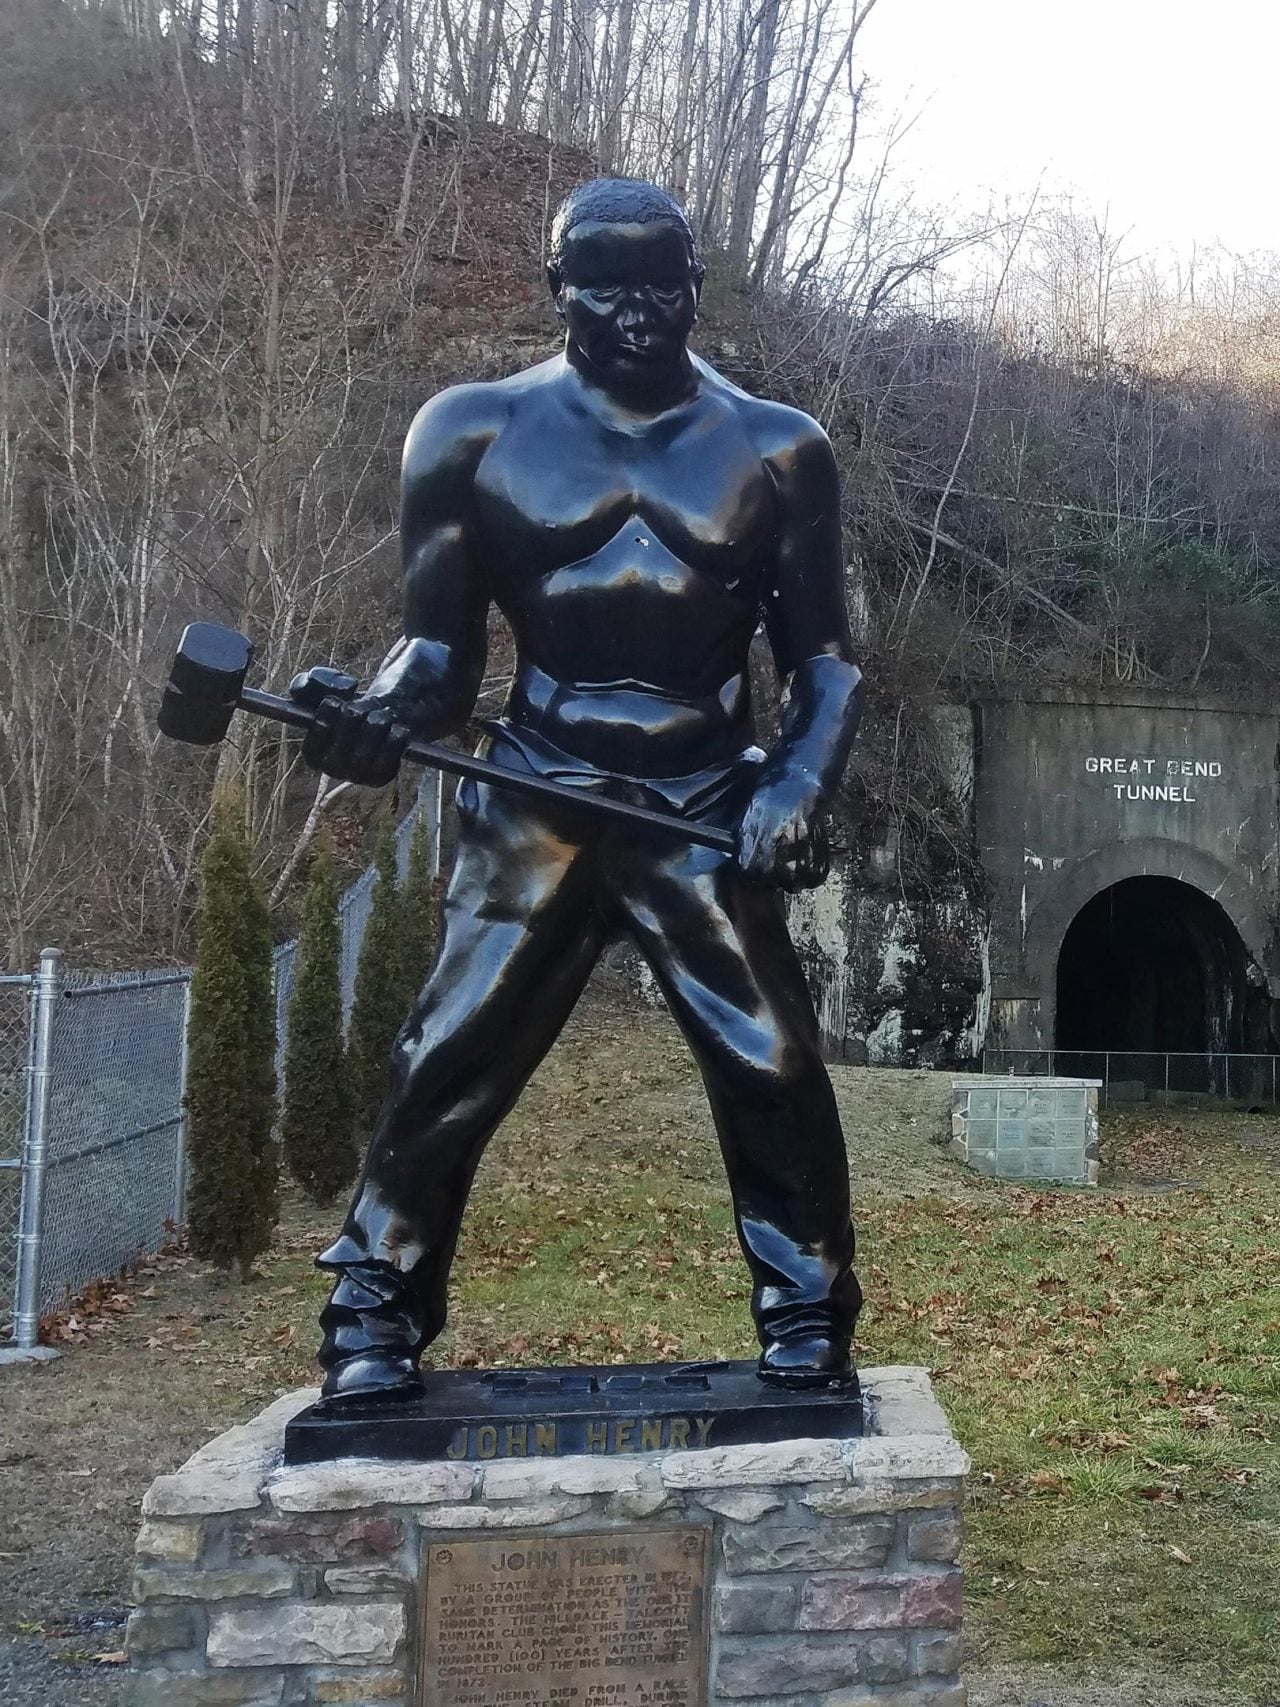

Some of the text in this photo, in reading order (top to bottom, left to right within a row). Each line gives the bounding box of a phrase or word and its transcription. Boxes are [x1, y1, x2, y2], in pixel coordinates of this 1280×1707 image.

[1085, 757, 1223, 777] GREAT BEND
[1113, 784, 1196, 802] TUNNEL
[446, 1416, 717, 1460] JOHN HENRY
[491, 1546, 646, 1572] JOHN HENRY
[454, 1583, 483, 1592] THIS
[579, 1574, 638, 1586] ERECTED
[440, 1596, 457, 1606] BY
[466, 1595, 475, 1604] A
[484, 1592, 533, 1604] GROUP
[567, 1587, 618, 1599] PEOPLE
[626, 1584, 658, 1595] WITH
[440, 1608, 476, 1618] SAME
[482, 1601, 586, 1616] DETERMINATION
[592, 1600, 609, 1609] AS
[615, 1597, 640, 1607] THE
[439, 1618, 688, 1641] RURITAN CLUB CHOSE THIS MEMORIAL
[440, 1618, 501, 1629] HONORS.
[511, 1615, 537, 1625] THE
[438, 1653, 500, 1665] HUNDRED
[555, 1647, 600, 1659] YEARS
[609, 1643, 653, 1655] AFTER
[439, 1643, 458, 1653] TO
[467, 1641, 503, 1651] MARK
[513, 1640, 523, 1649] A
[532, 1637, 565, 1648] PAGE
[574, 1635, 592, 1646] OF
[438, 1664, 522, 1677] COMPLETION
[527, 1662, 543, 1672] OF
[550, 1660, 574, 1671] THE
[579, 1658, 601, 1669] BIG
[452, 1693, 487, 1704] JOHN
[496, 1690, 538, 1702] HENRY
[550, 1687, 578, 1698] DIED
[588, 1684, 626, 1695] FROM
[635, 1682, 645, 1692] A
